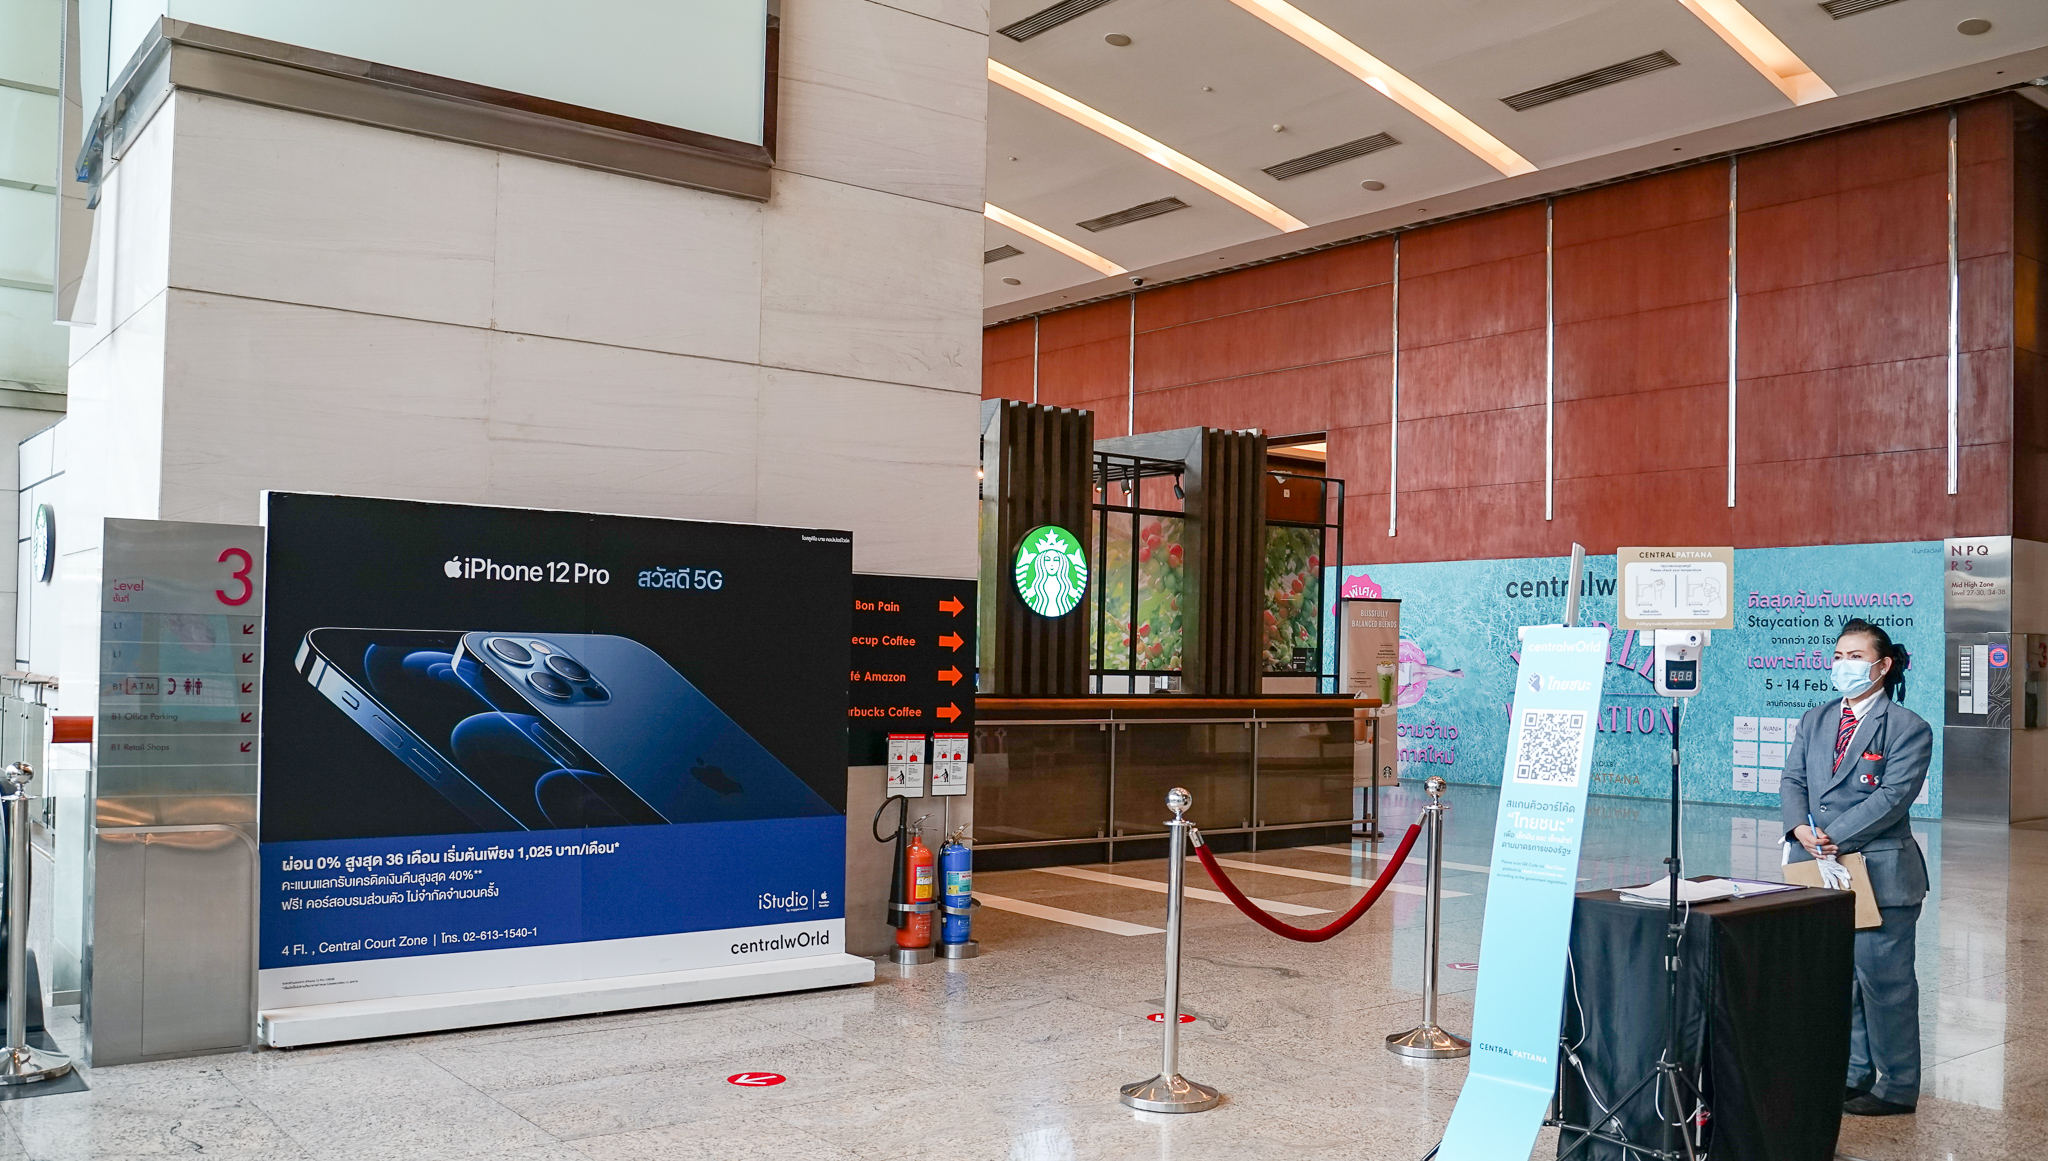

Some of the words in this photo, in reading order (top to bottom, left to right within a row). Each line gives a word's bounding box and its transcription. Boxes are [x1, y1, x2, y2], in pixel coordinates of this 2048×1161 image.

[1639, 551, 1713, 559] CENTRALPATTANA
[1951, 545, 1962, 556] N
[215, 547, 253, 606] 3
[464, 557, 543, 582] iPhone
[546, 562, 570, 583] 12
[574, 563, 610, 585] Pro
[638, 566, 690, 589] สวัสดี
[693, 570, 723, 590] 5G
[114, 579, 144, 592] Level
[1964, 581, 1978, 589] High
[855, 600, 875, 610] Bon
[878, 601, 900, 612] Pain
[1747, 589, 1914, 613] ดีลสุดคุ้มกับแพคเกจ
[1360, 609, 1389, 617] BLISSFULLY
[1351, 620, 1378, 628] BALANCED
[1378, 620, 1397, 628] BLENDS
[1748, 615, 1820, 631] Staycation
[1824, 616, 1834, 628] &
[1838, 614, 1914, 628] Wkation
[851, 636, 879, 647] ecup
[882, 635, 916, 646] Coffee
[1528, 640, 1601, 653] centralwOrld
[1808, 636, 1820, 645] 20
[2038, 643, 2048, 669] 3
[864, 671, 906, 682] Amazon
[1547, 675, 1592, 692] ไทยชนะ
[1765, 678, 1773, 690] 5
[1787, 679, 1800, 690] 14
[1804, 679, 1828, 691] Feb
[151, 713, 178, 722] Parking
[888, 706, 922, 717] Coffee
[147, 744, 169, 752] Shops
[282, 856, 313, 871] ผ่อน
[317, 856, 341, 870] 0%
[345, 855, 383, 872] สูงสุด
[386, 853, 403, 866] 36
[407, 849, 440, 865] เดือน
[443, 845, 514, 863] เริ่มต้นเพียง
[518, 845, 552, 860] 1,025
[281, 871, 446, 891] คะแนนแลกรับเครดิตเงินคืนสูงสุด
[281, 897, 303, 910] ฟรี!
[306, 892, 404, 909] คอร์สอบรมส่วนตัว
[406, 882, 499, 902] ไม่จำกัดจำนวนครั้ง
[759, 891, 809, 910] iStudio
[281, 945, 290, 956] 4
[319, 939, 361, 954] Central
[364, 937, 396, 950] Court
[399, 936, 428, 947] Zone
[463, 927, 538, 942] 02-613-1540-1
[731, 930, 830, 954] centralwOrld
[1479, 1043, 1548, 1064] CENTRALPATTANA
